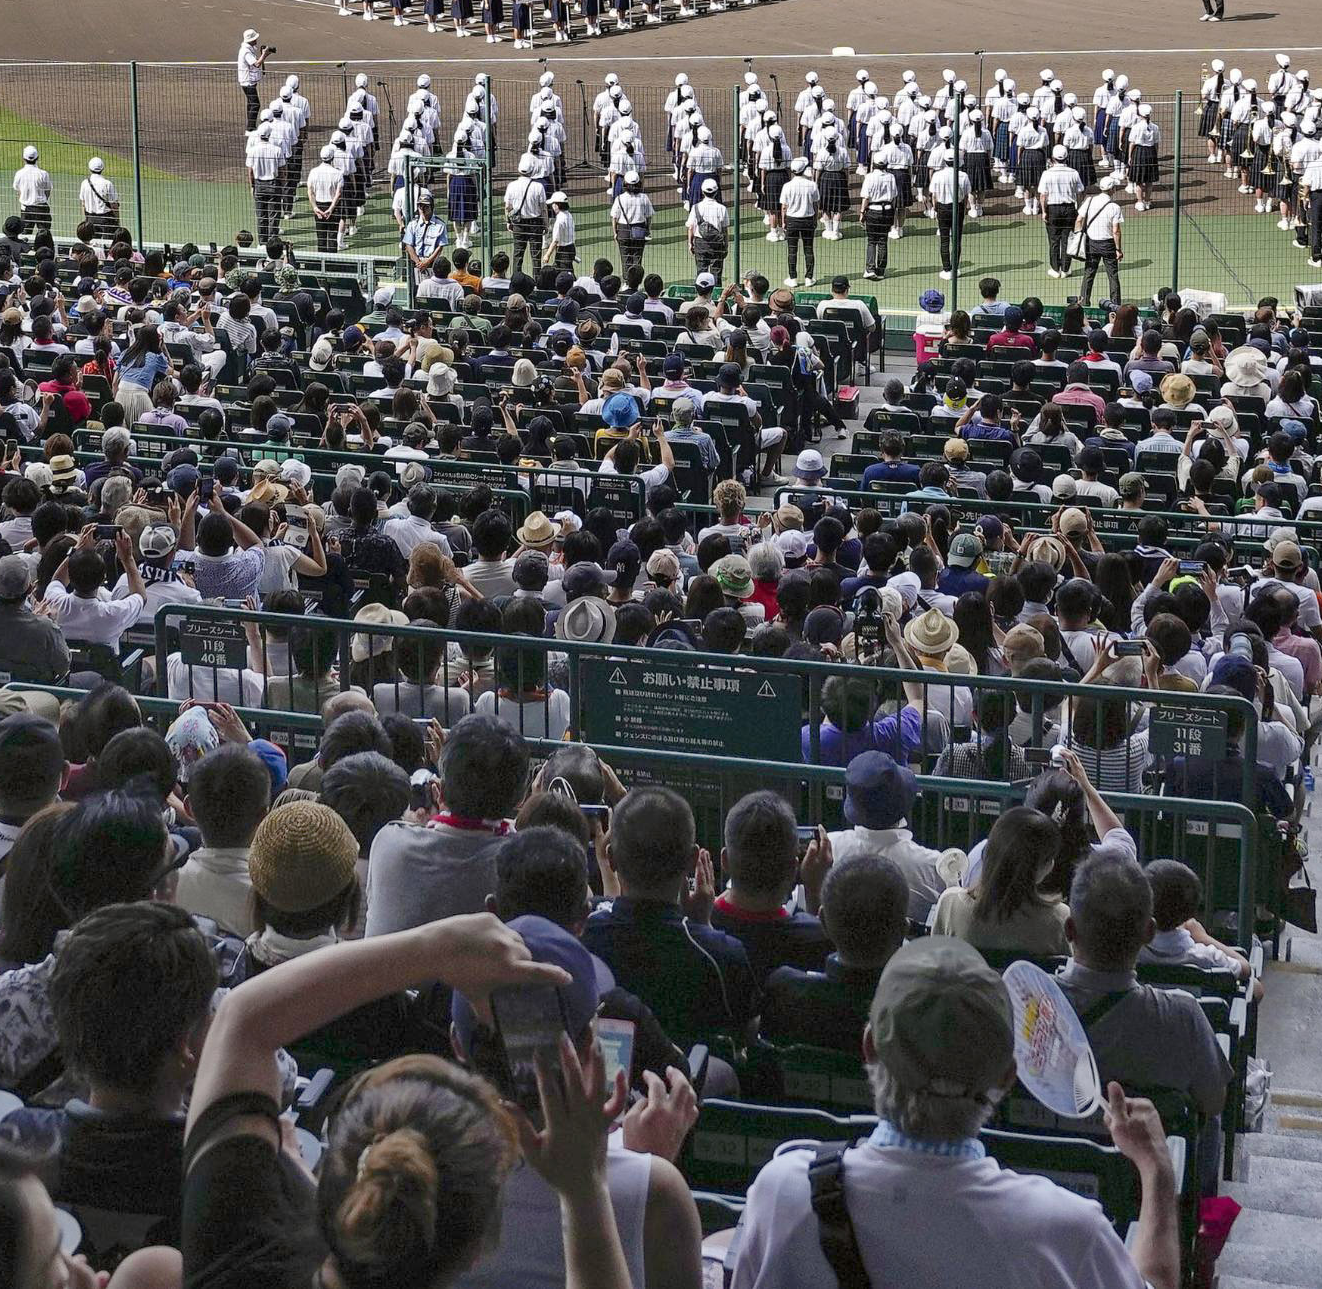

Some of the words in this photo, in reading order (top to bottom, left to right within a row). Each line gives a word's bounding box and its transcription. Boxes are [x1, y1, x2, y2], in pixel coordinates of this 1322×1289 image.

[186, 624, 239, 636] ブリーズシート
[202, 639, 225, 653] 11段
[200, 653, 226, 665] 40番
[642, 671, 740, 694] お願い・禁止事項
[1159, 710, 1220, 725] ブリーズシート
[1176, 728, 1202, 742] 11段
[1173, 742, 1203, 756] 31番
